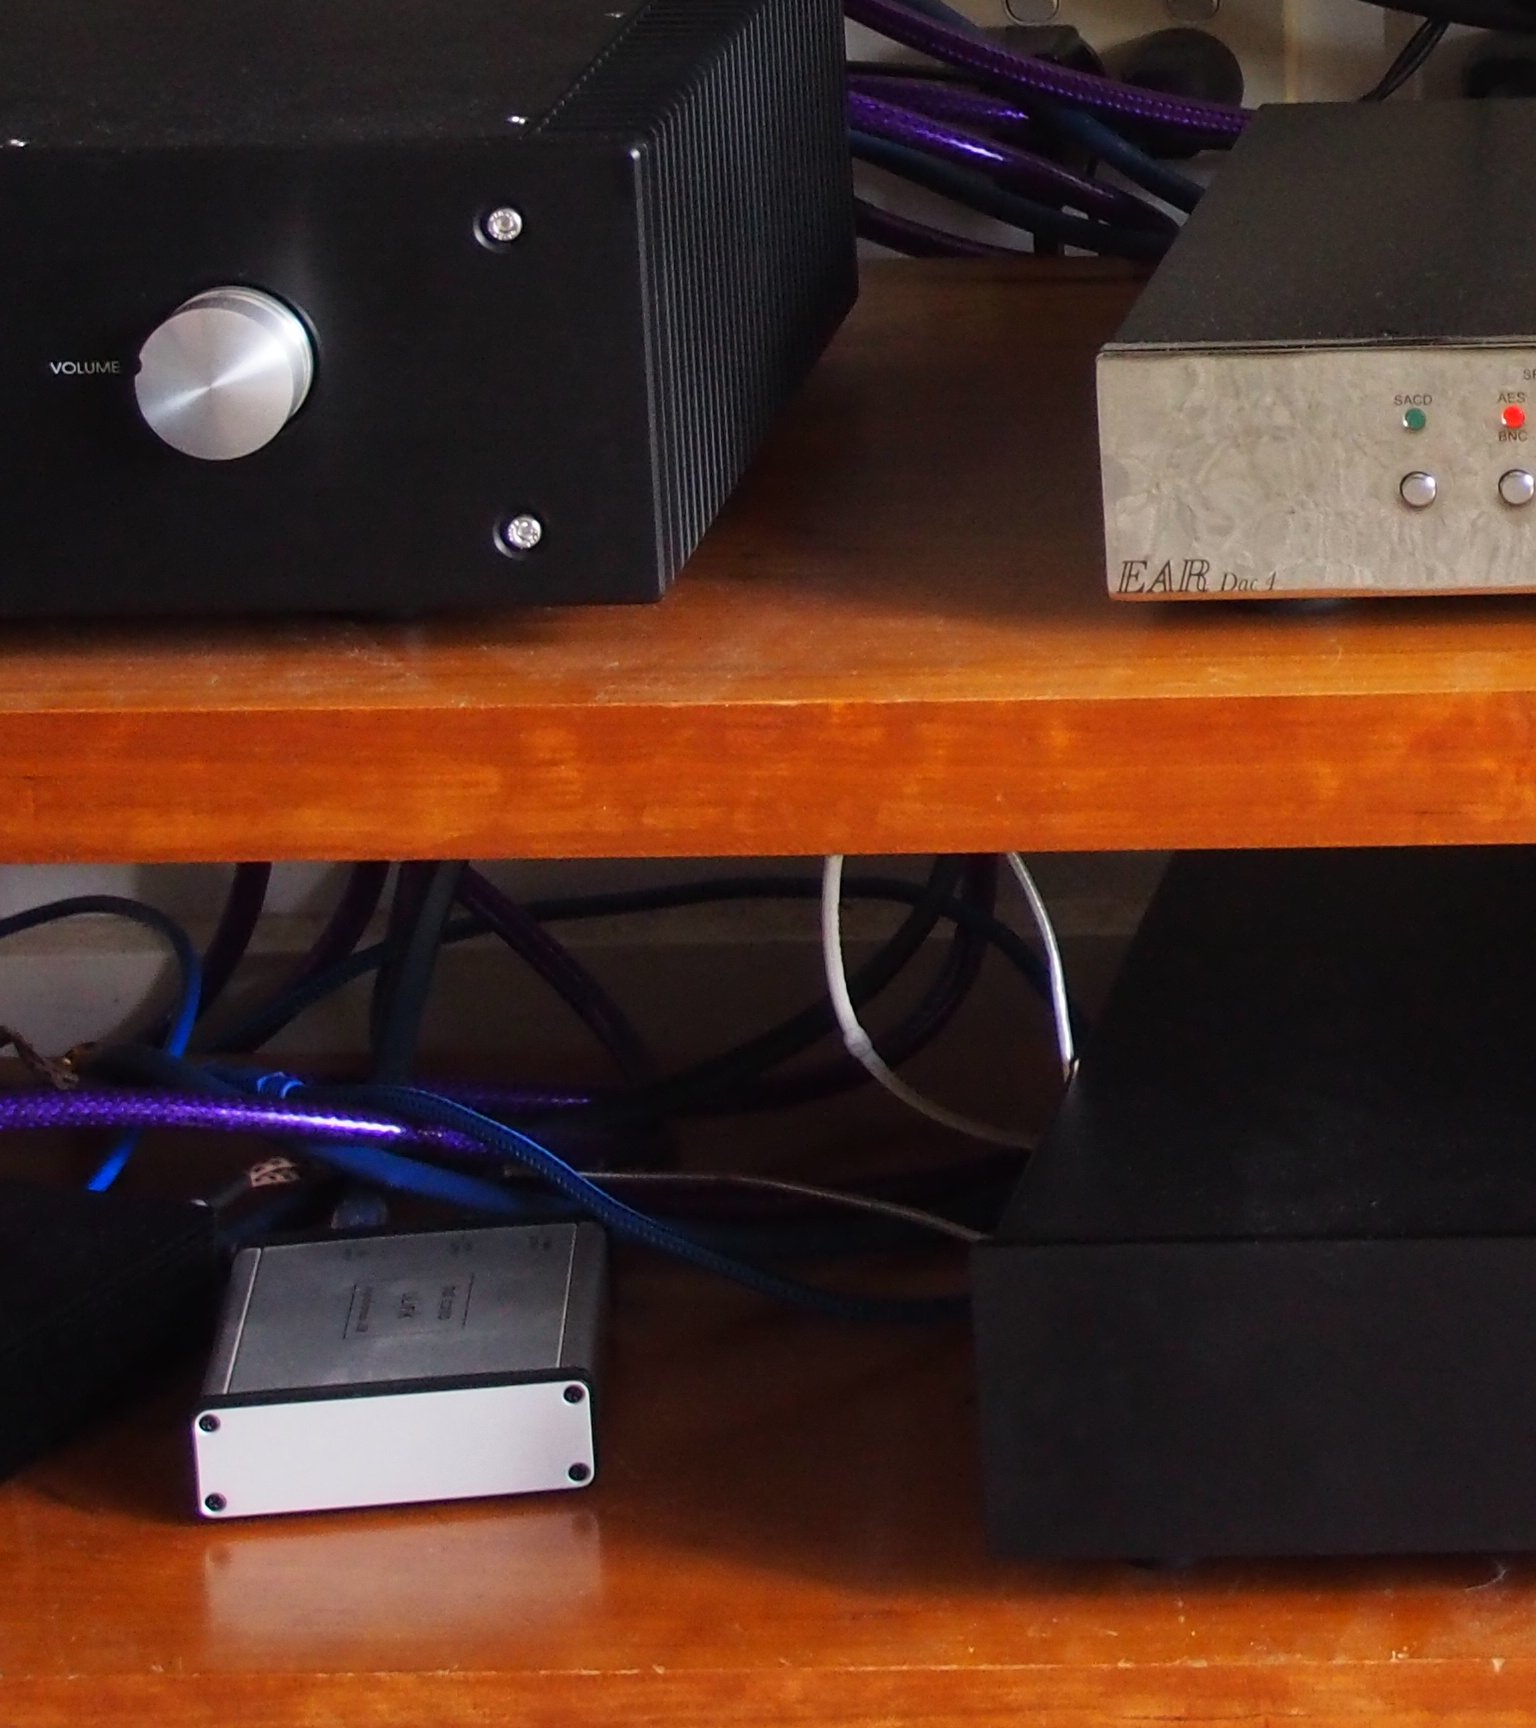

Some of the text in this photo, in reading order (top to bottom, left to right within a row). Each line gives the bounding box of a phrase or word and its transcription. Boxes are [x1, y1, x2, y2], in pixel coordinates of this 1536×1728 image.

[50, 361, 120, 375] VOLUME
[1393, 394, 1432, 406] SACD
[1497, 392, 1526, 404] AES
[1498, 430, 1528, 442] BNC
[1116, 559, 1211, 594] EAR
